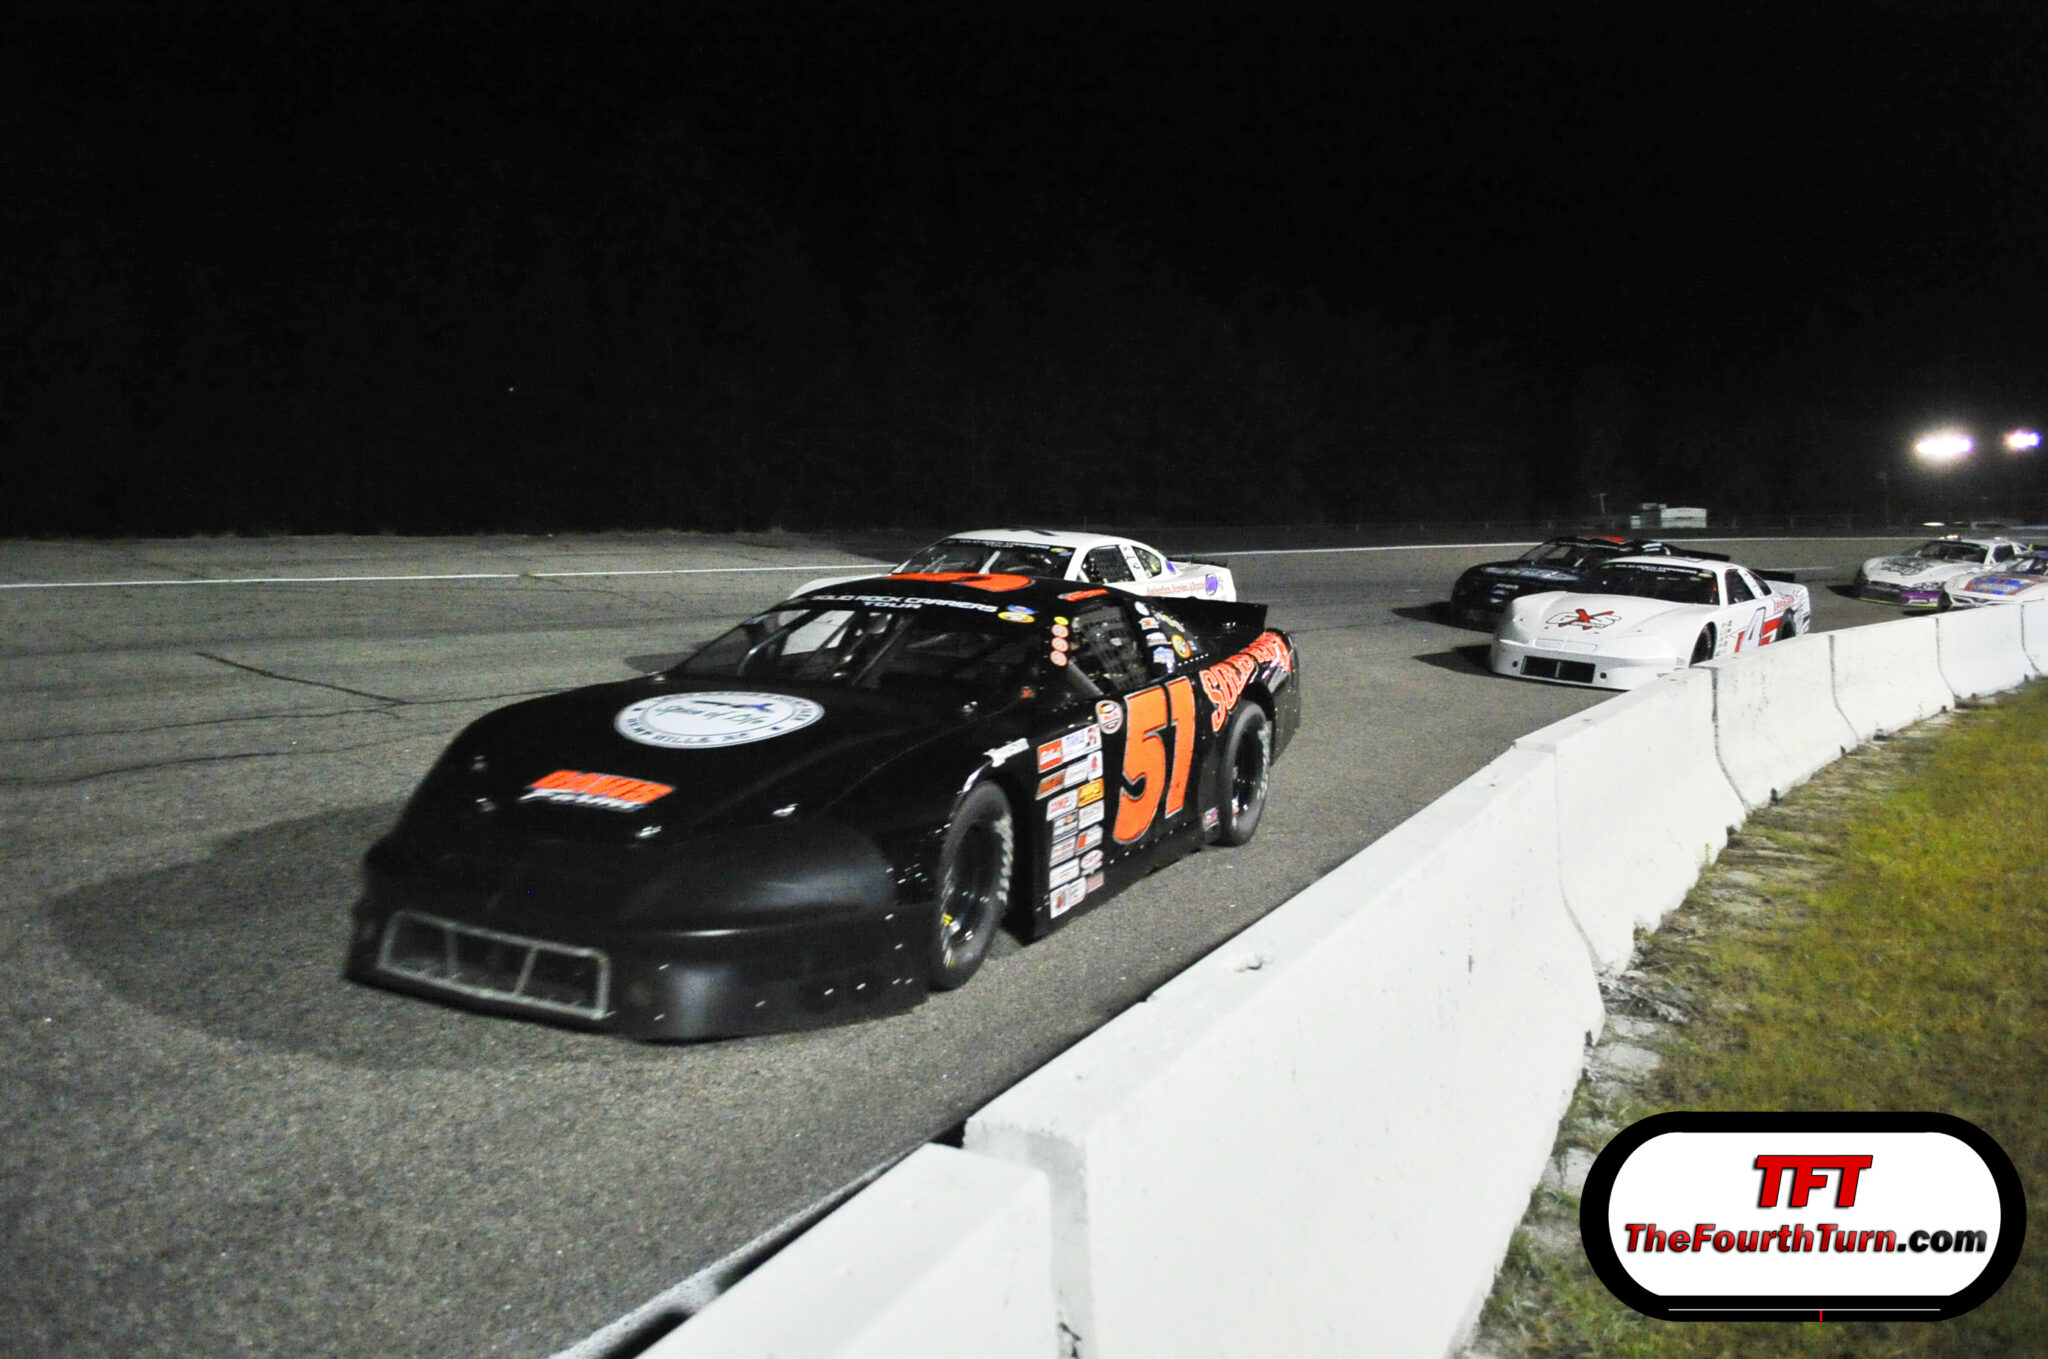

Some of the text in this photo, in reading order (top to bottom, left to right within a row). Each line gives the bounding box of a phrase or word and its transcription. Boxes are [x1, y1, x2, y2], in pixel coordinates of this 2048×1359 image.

[855, 594, 902, 603] ROCK
[905, 597, 999, 612] CARRIERS
[863, 601, 922, 609] TOUR
[1112, 676, 1196, 845] 51
